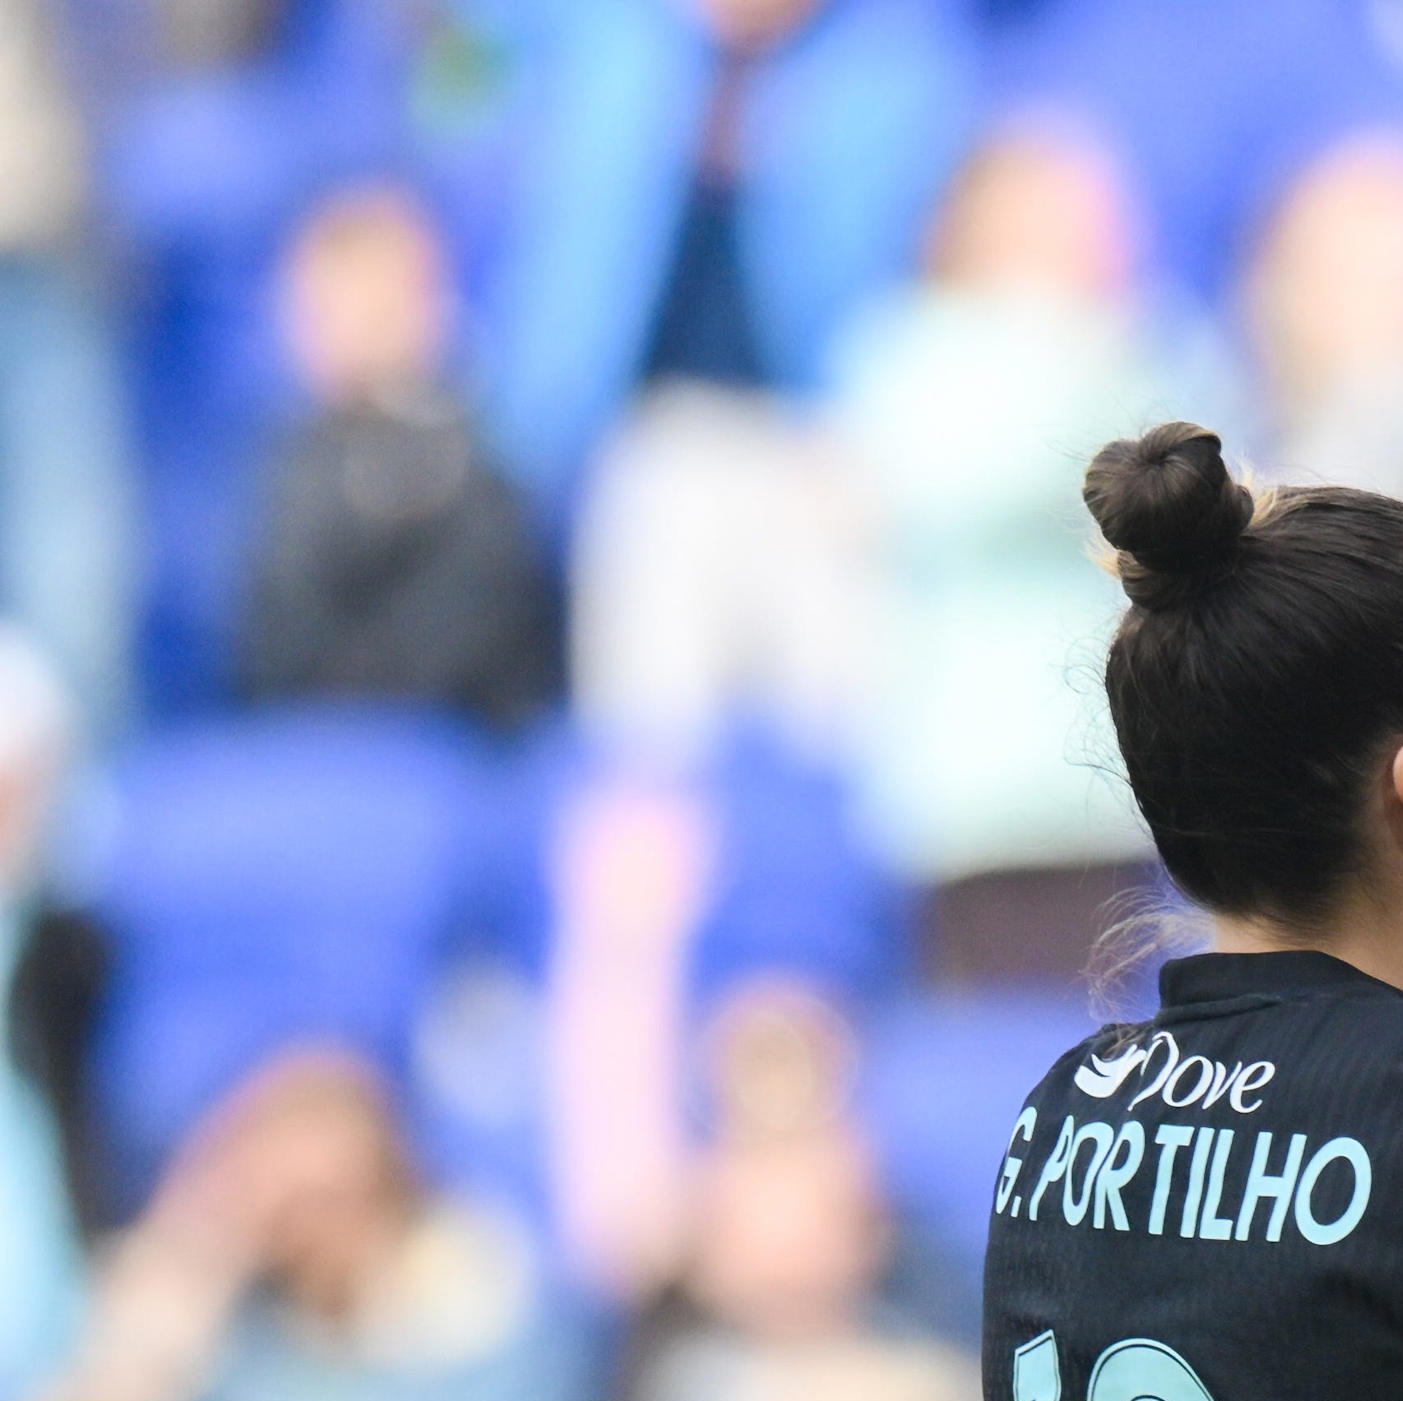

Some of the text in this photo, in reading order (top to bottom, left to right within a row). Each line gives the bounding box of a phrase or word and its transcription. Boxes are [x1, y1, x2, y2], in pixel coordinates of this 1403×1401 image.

[1140, 1031, 1275, 1113] Dove
[996, 1106, 1372, 1246] G. PORTILHO
